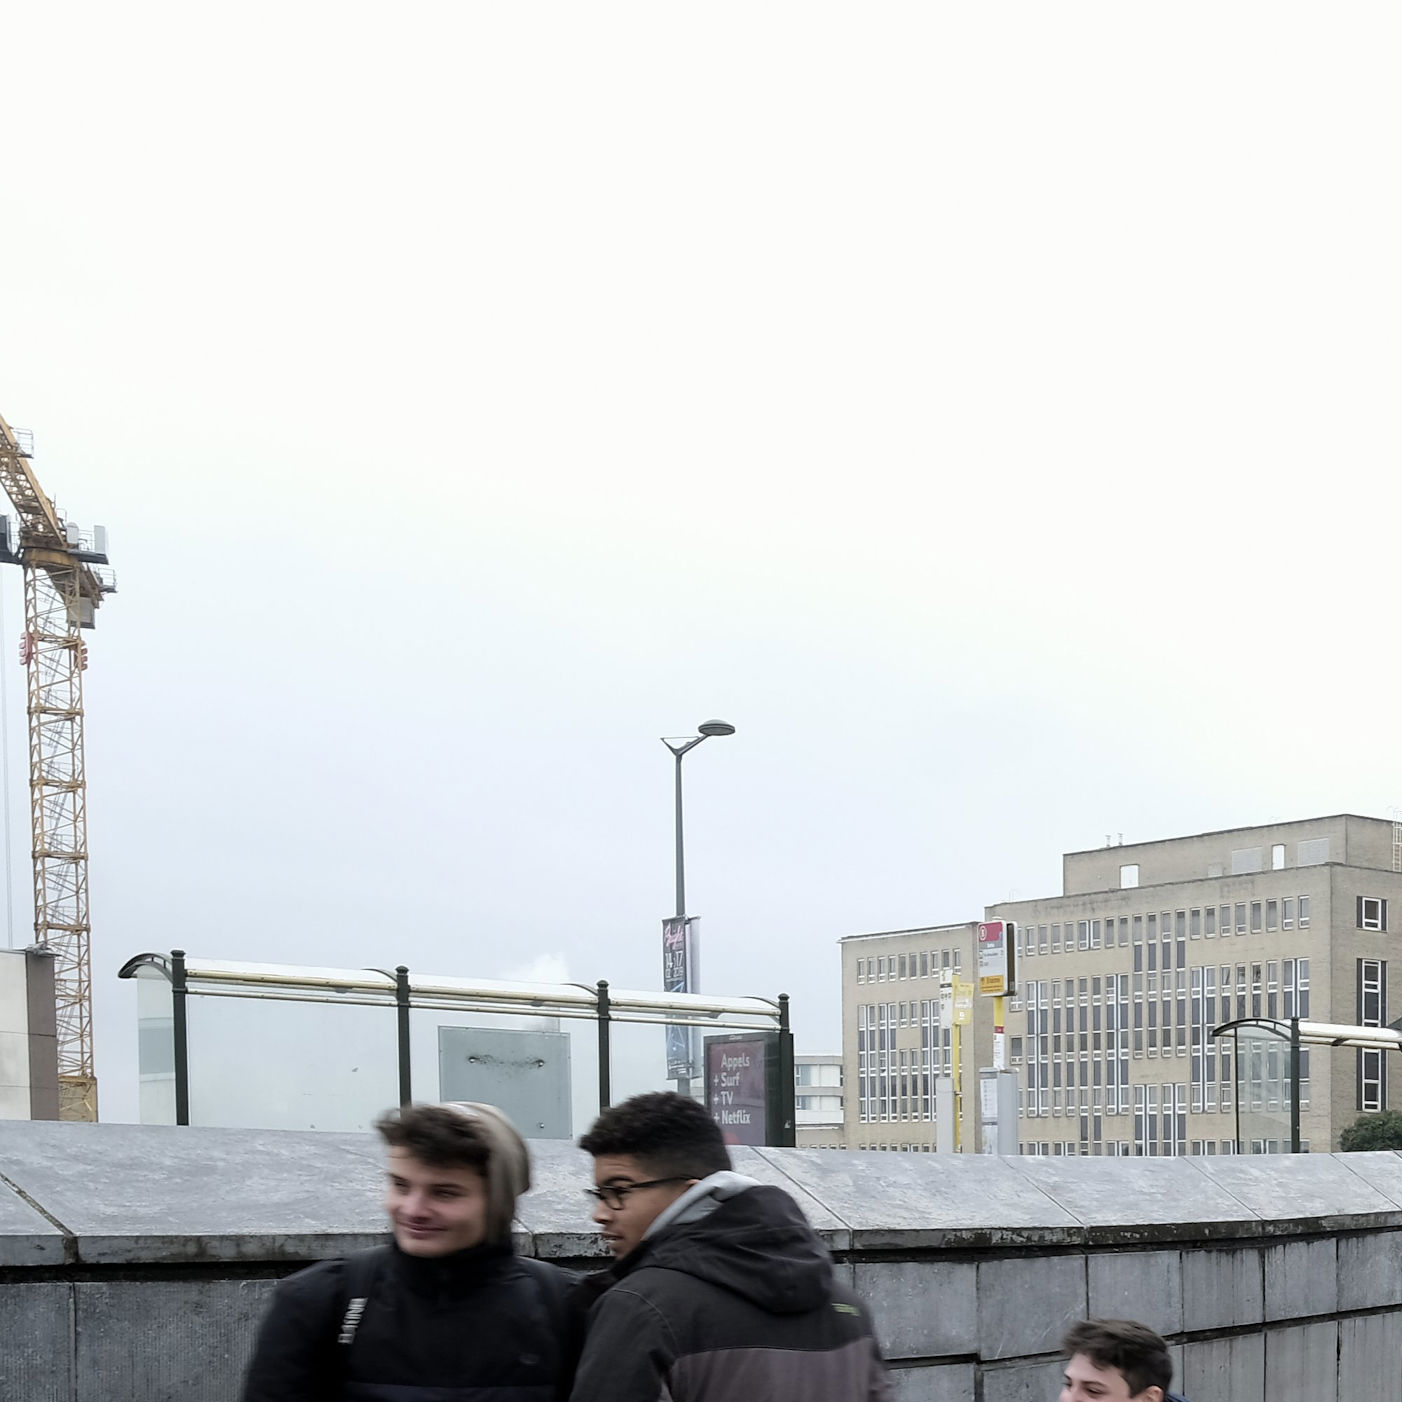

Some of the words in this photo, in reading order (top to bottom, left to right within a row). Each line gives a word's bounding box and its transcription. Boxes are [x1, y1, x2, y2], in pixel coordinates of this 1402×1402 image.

[721, 1053, 750, 1071] Appels
[720, 1072, 741, 1087] Surf
[720, 1090, 734, 1105] TV
[721, 1109, 752, 1125] Netflix
